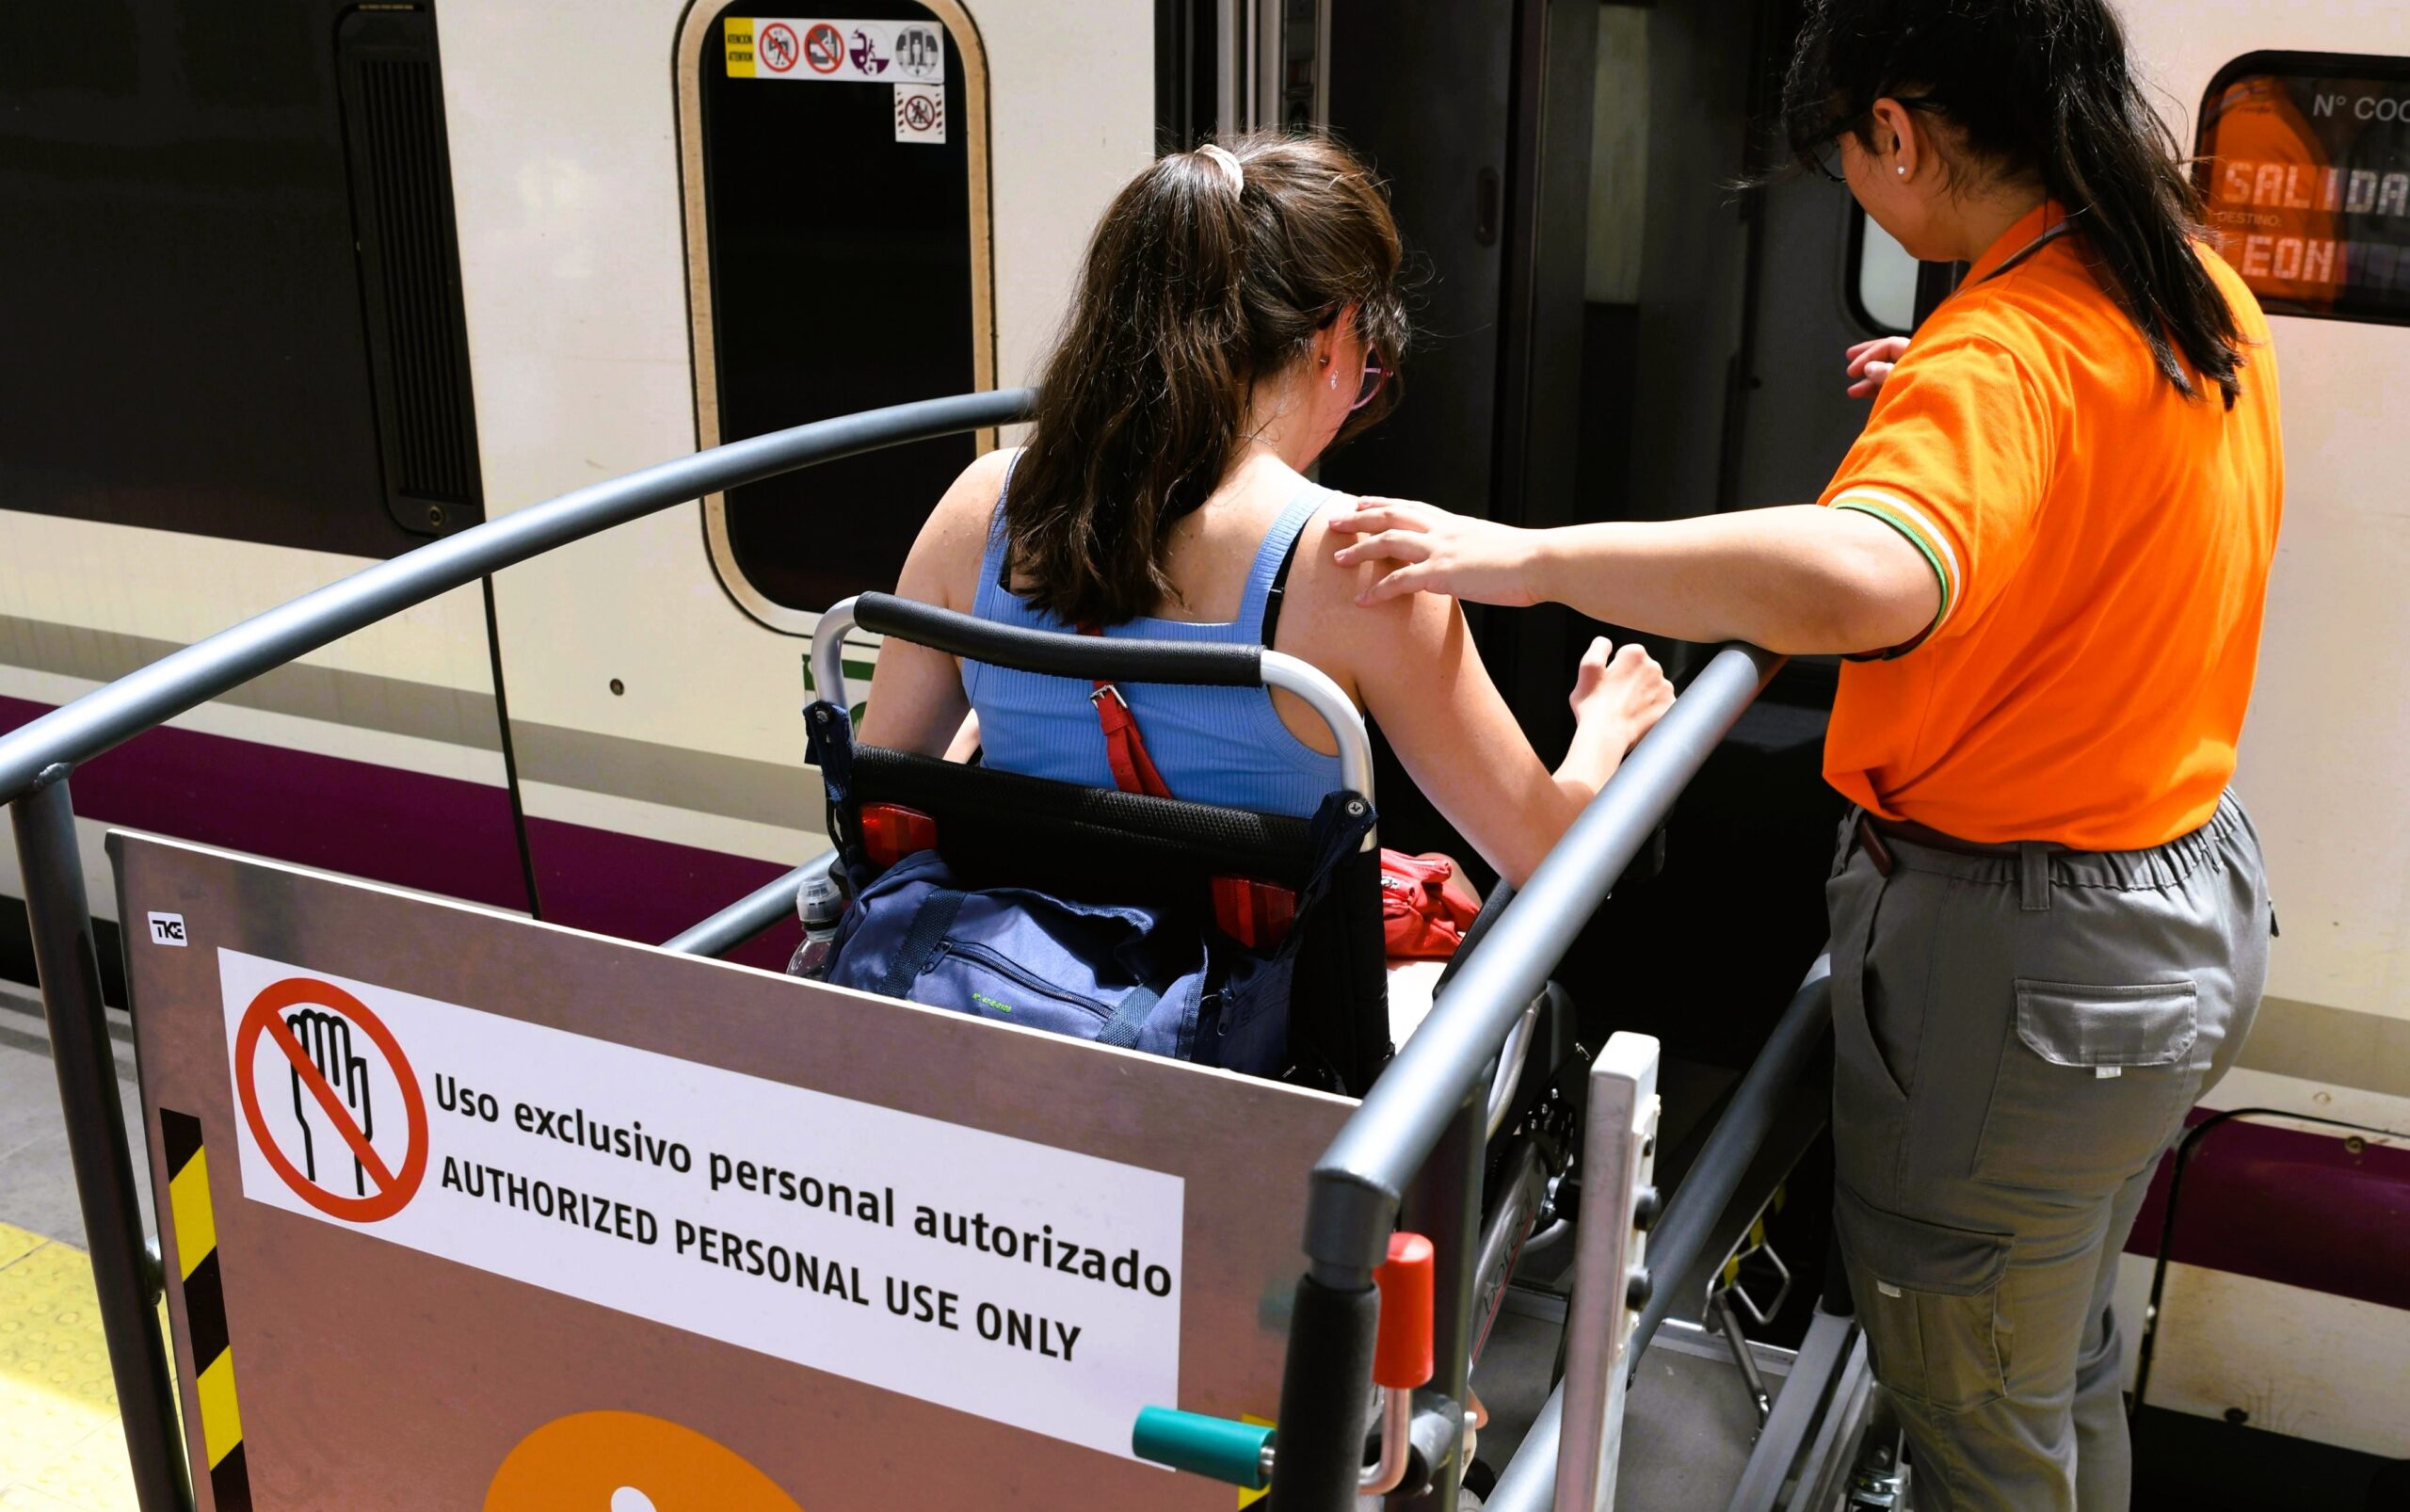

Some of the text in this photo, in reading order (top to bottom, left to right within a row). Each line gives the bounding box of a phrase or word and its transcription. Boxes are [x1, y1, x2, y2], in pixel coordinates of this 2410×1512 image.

[2223, 164, 2409, 216] SALIDA
[152, 919, 185, 940] TKE
[435, 1072, 1172, 1298] Uso exclusivo personal autorizado
[442, 1155, 1082, 1362] AUTHORIZED PERSONAL USE ONLY
